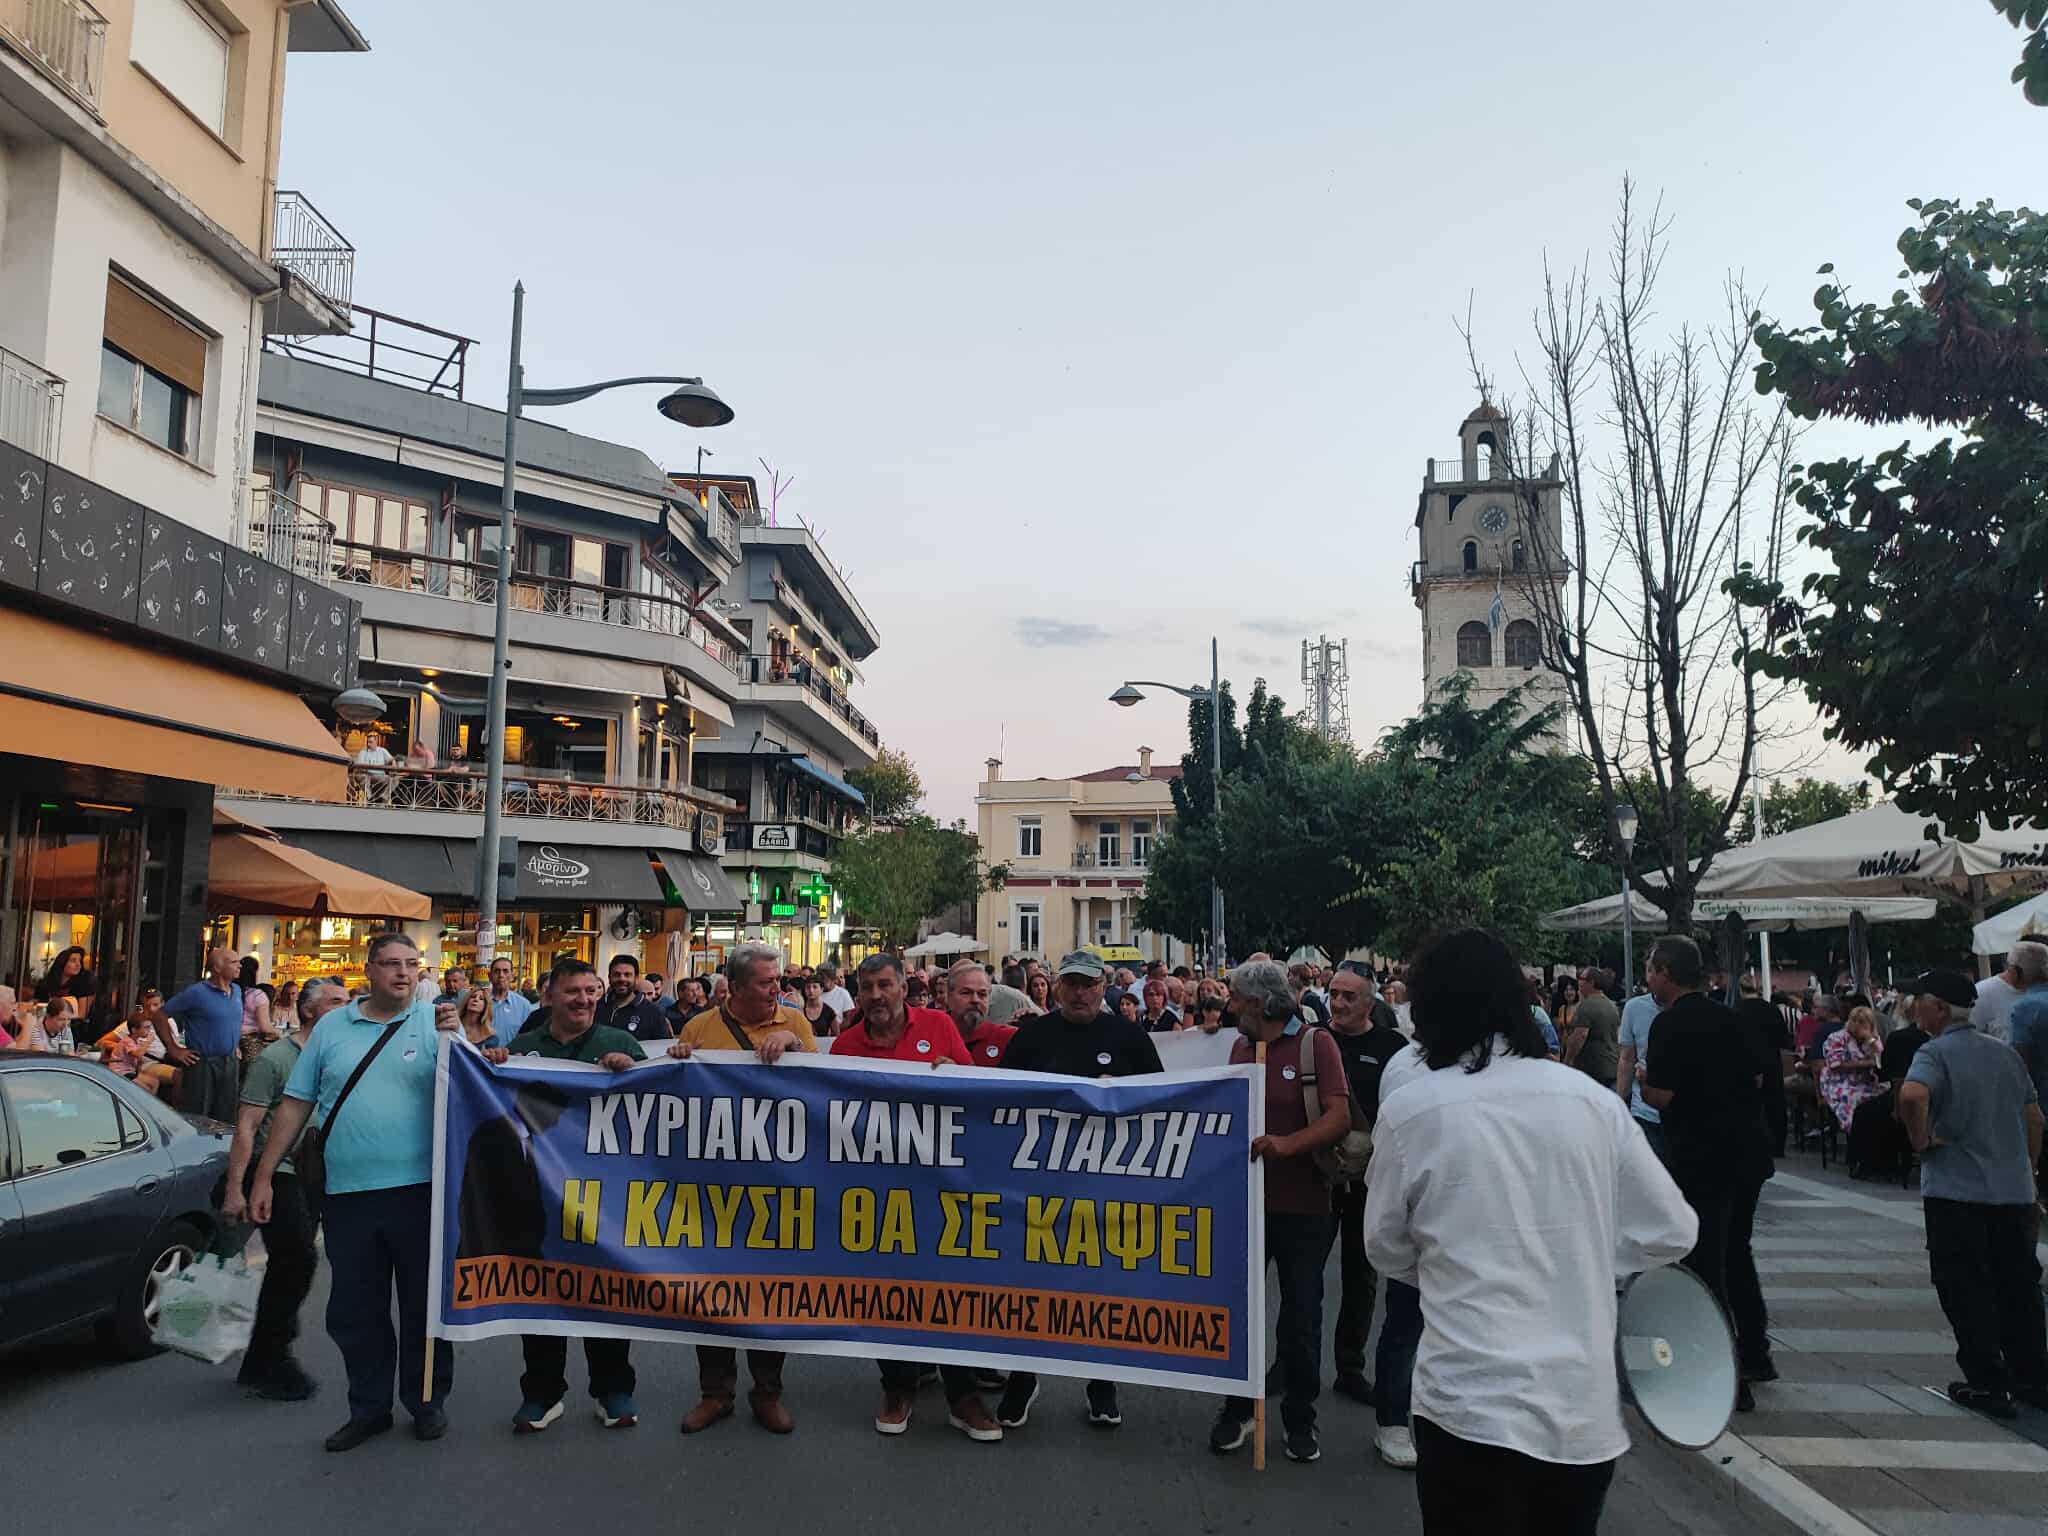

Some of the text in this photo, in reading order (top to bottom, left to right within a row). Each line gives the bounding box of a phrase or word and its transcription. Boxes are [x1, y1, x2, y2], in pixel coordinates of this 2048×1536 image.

[1858, 849, 1921, 877] mikel
[586, 1093, 1232, 1179] ΚΥΡΙΑΚΟ ΚΑΝΕ "ΣΤΑΣΣΗ"
[562, 1178, 1214, 1278] Η ΚΑΥΣΗ ΘΑ ΣΕ ΚΑΨΕΙ
[456, 1261, 1225, 1354] ΣΥΛΛΟΓΟΙ ΔΗΜΟΤΙΚΩΝ ΥΠΑΛΛΗΛΩΝ ΔΥΤΙΚΗΣ ΜΑΚΕΔΟΝΙΑΣ
